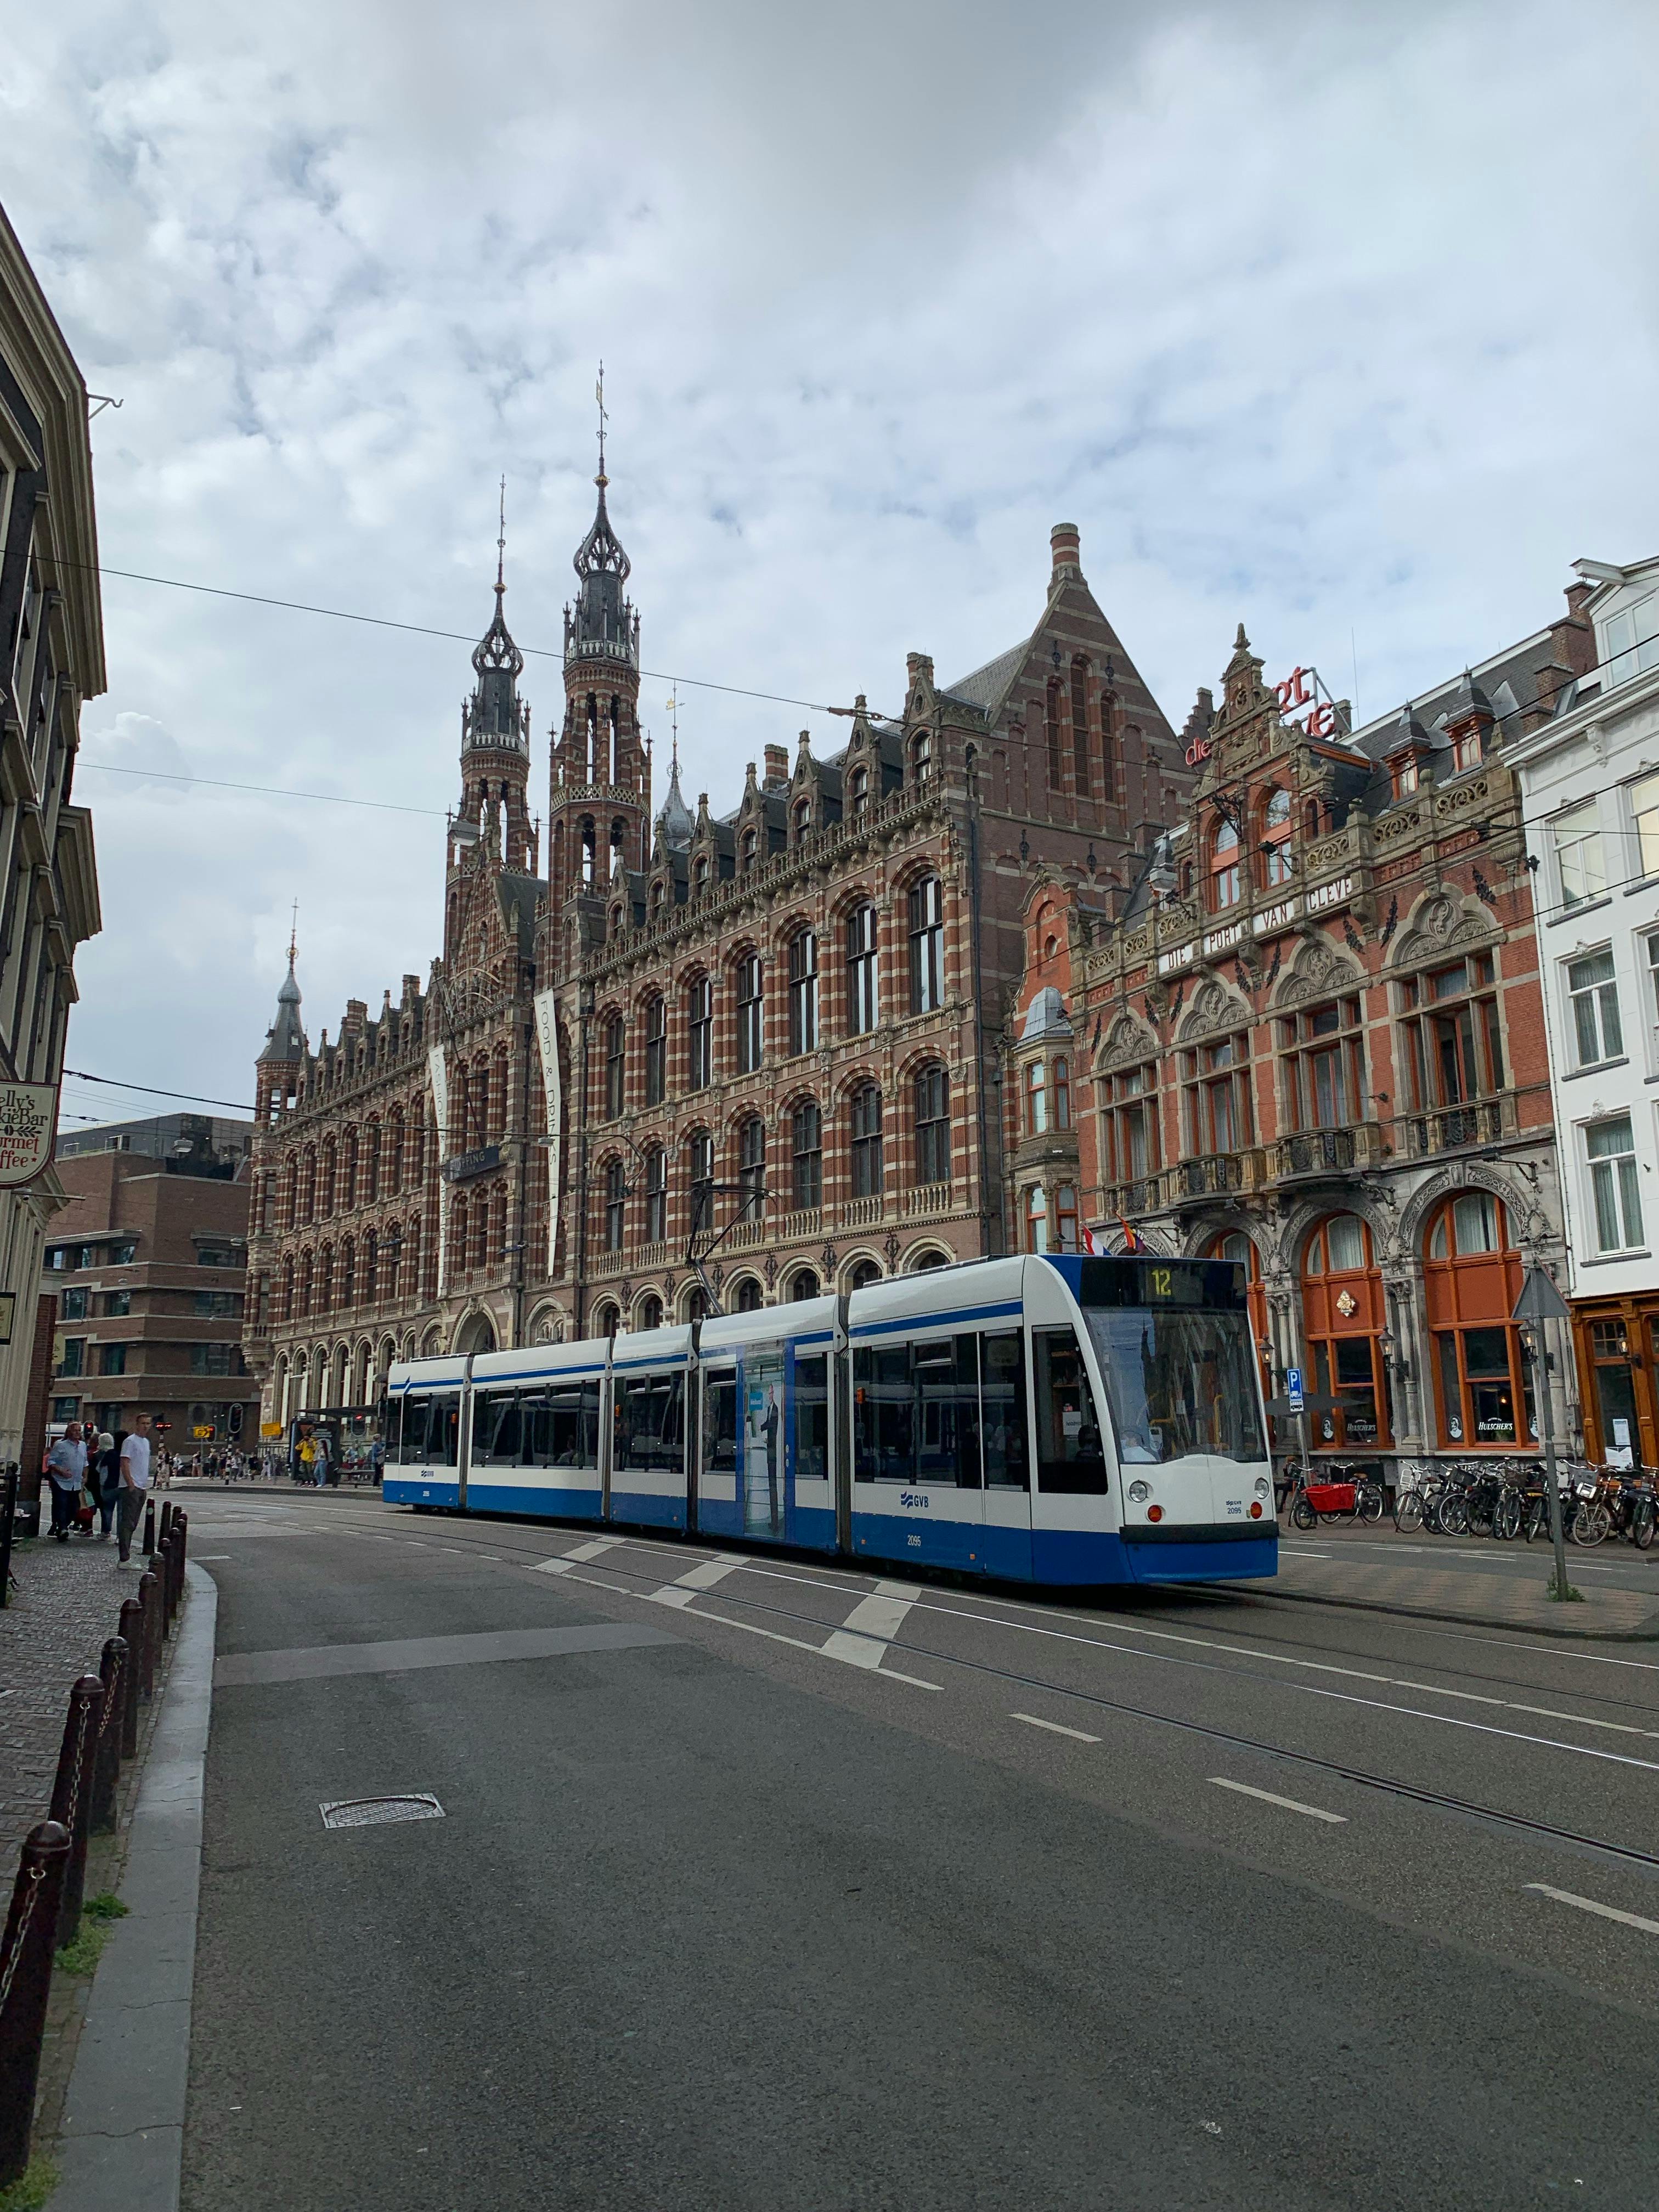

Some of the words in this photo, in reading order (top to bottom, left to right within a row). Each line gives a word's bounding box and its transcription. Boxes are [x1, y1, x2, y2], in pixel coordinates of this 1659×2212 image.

[1168, 947, 1186, 968] DIE
[1210, 926, 1239, 952] PORT
[1263, 903, 1287, 929] VAN
[1309, 879, 1352, 910] CLEVE
[540, 1000, 551, 1055] FOOD
[546, 1066, 552, 1076] &
[435, 1054, 443, 1125] FASHION
[1152, 1269, 1171, 1295] 12
[1290, 1372, 1297, 1388] P
[1347, 1423, 1376, 1431] HULSCHER'S
[1478, 1421, 1513, 1431] HULSCHER'S
[913, 1494, 929, 1508] GVB
[907, 1534, 922, 1547] 2095
